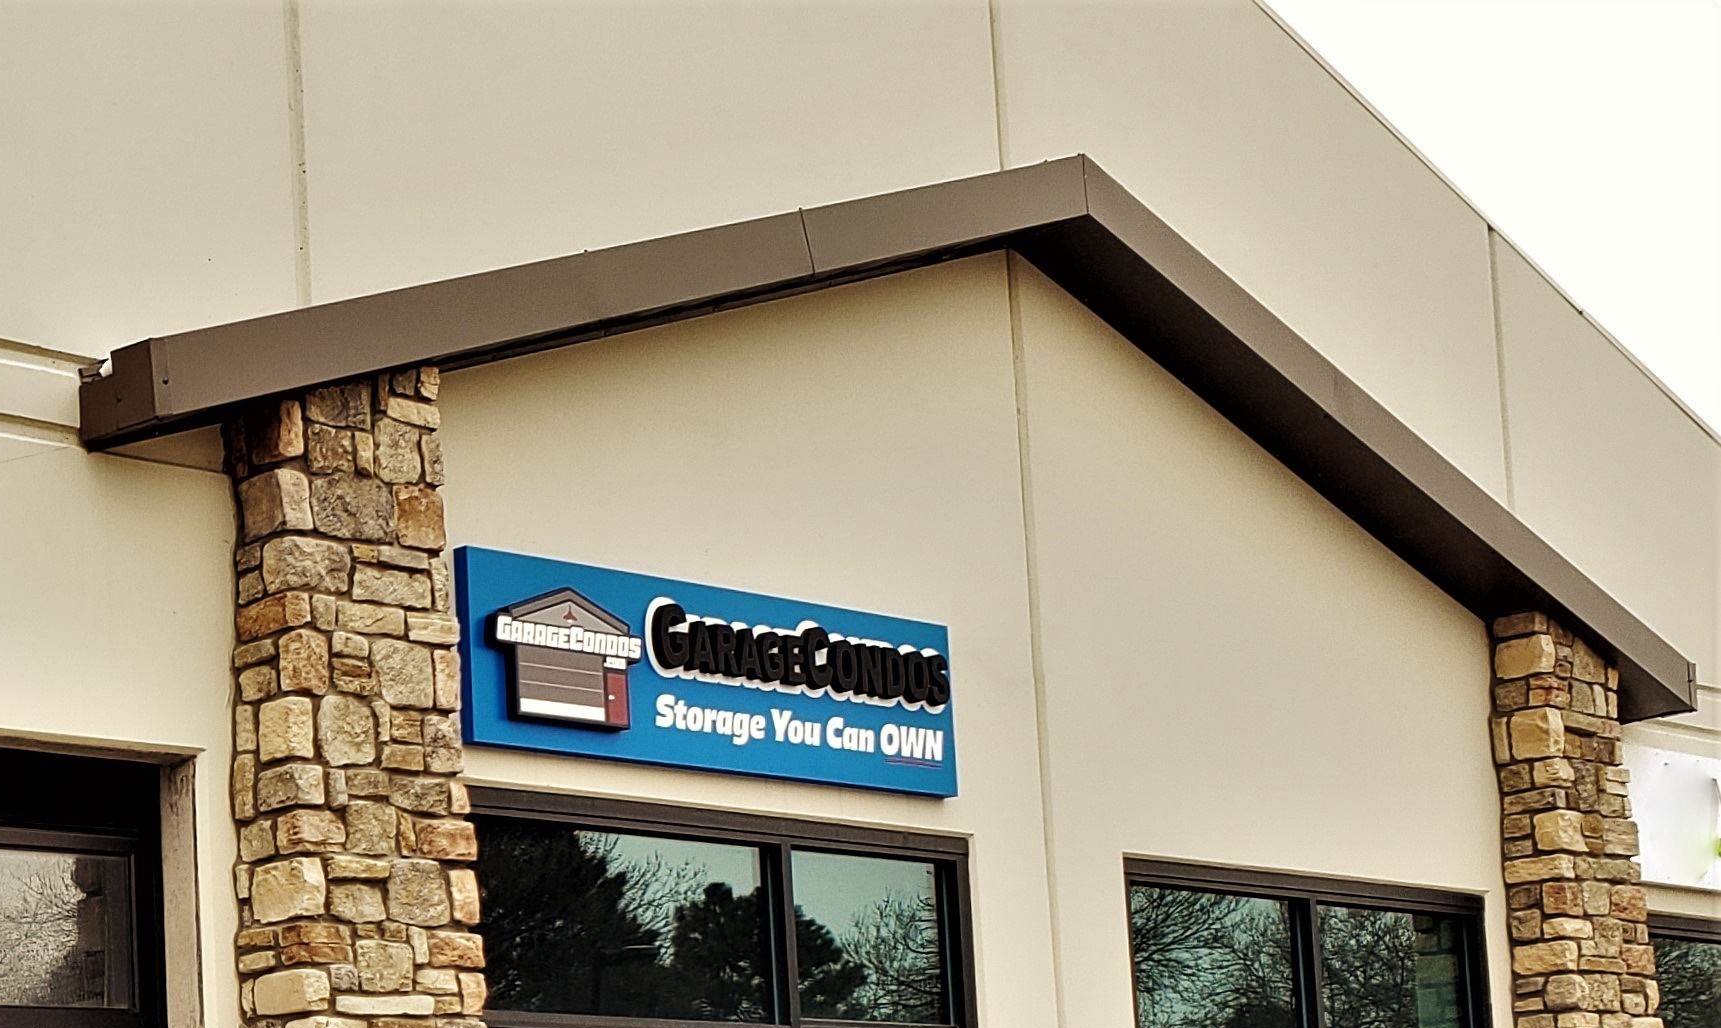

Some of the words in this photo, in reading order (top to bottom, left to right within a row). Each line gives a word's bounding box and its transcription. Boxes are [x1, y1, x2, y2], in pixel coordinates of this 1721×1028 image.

[496, 614, 642, 660] GARAGECONDOS
[648, 600, 951, 710] GARAGECONDOS
[655, 694, 765, 746] Storage
[771, 709, 821, 747] You
[826, 716, 875, 753] Can
[880, 723, 944, 762] OWN
